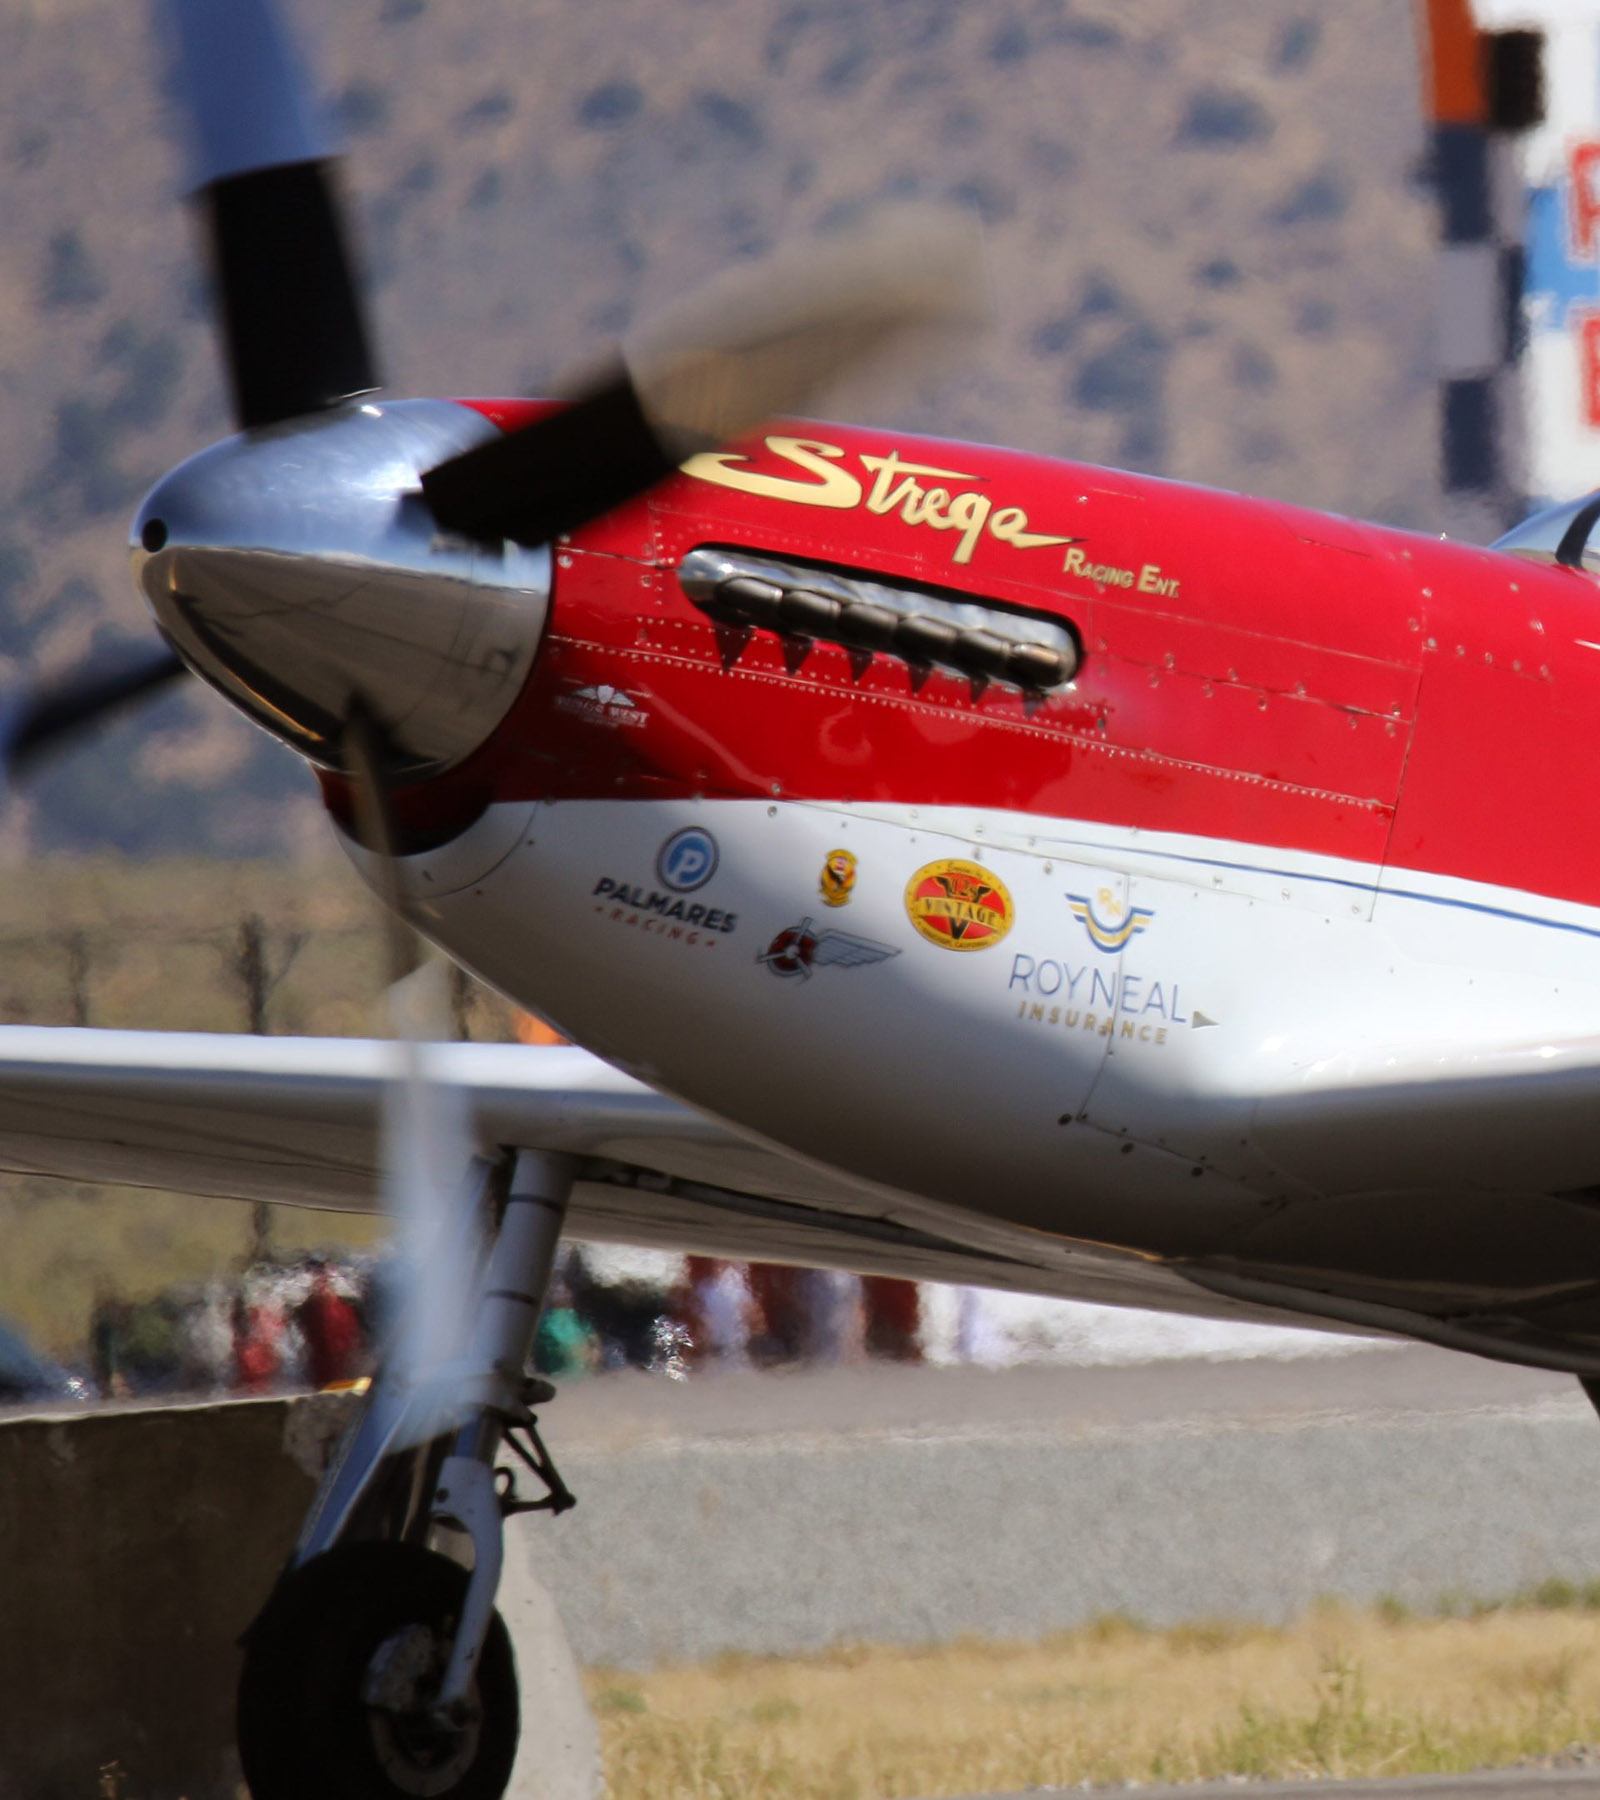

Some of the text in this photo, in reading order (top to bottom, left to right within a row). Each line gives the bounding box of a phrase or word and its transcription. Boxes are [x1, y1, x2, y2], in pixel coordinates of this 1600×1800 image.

[680, 435, 1089, 565] Strega
[1063, 549, 1180, 599] RACING ENT.
[592, 876, 738, 934] PALMARES
[610, 906, 700, 945] RACING
[924, 897, 998, 928] VINTAGE
[1018, 1000, 1169, 1045] INSURANCE
